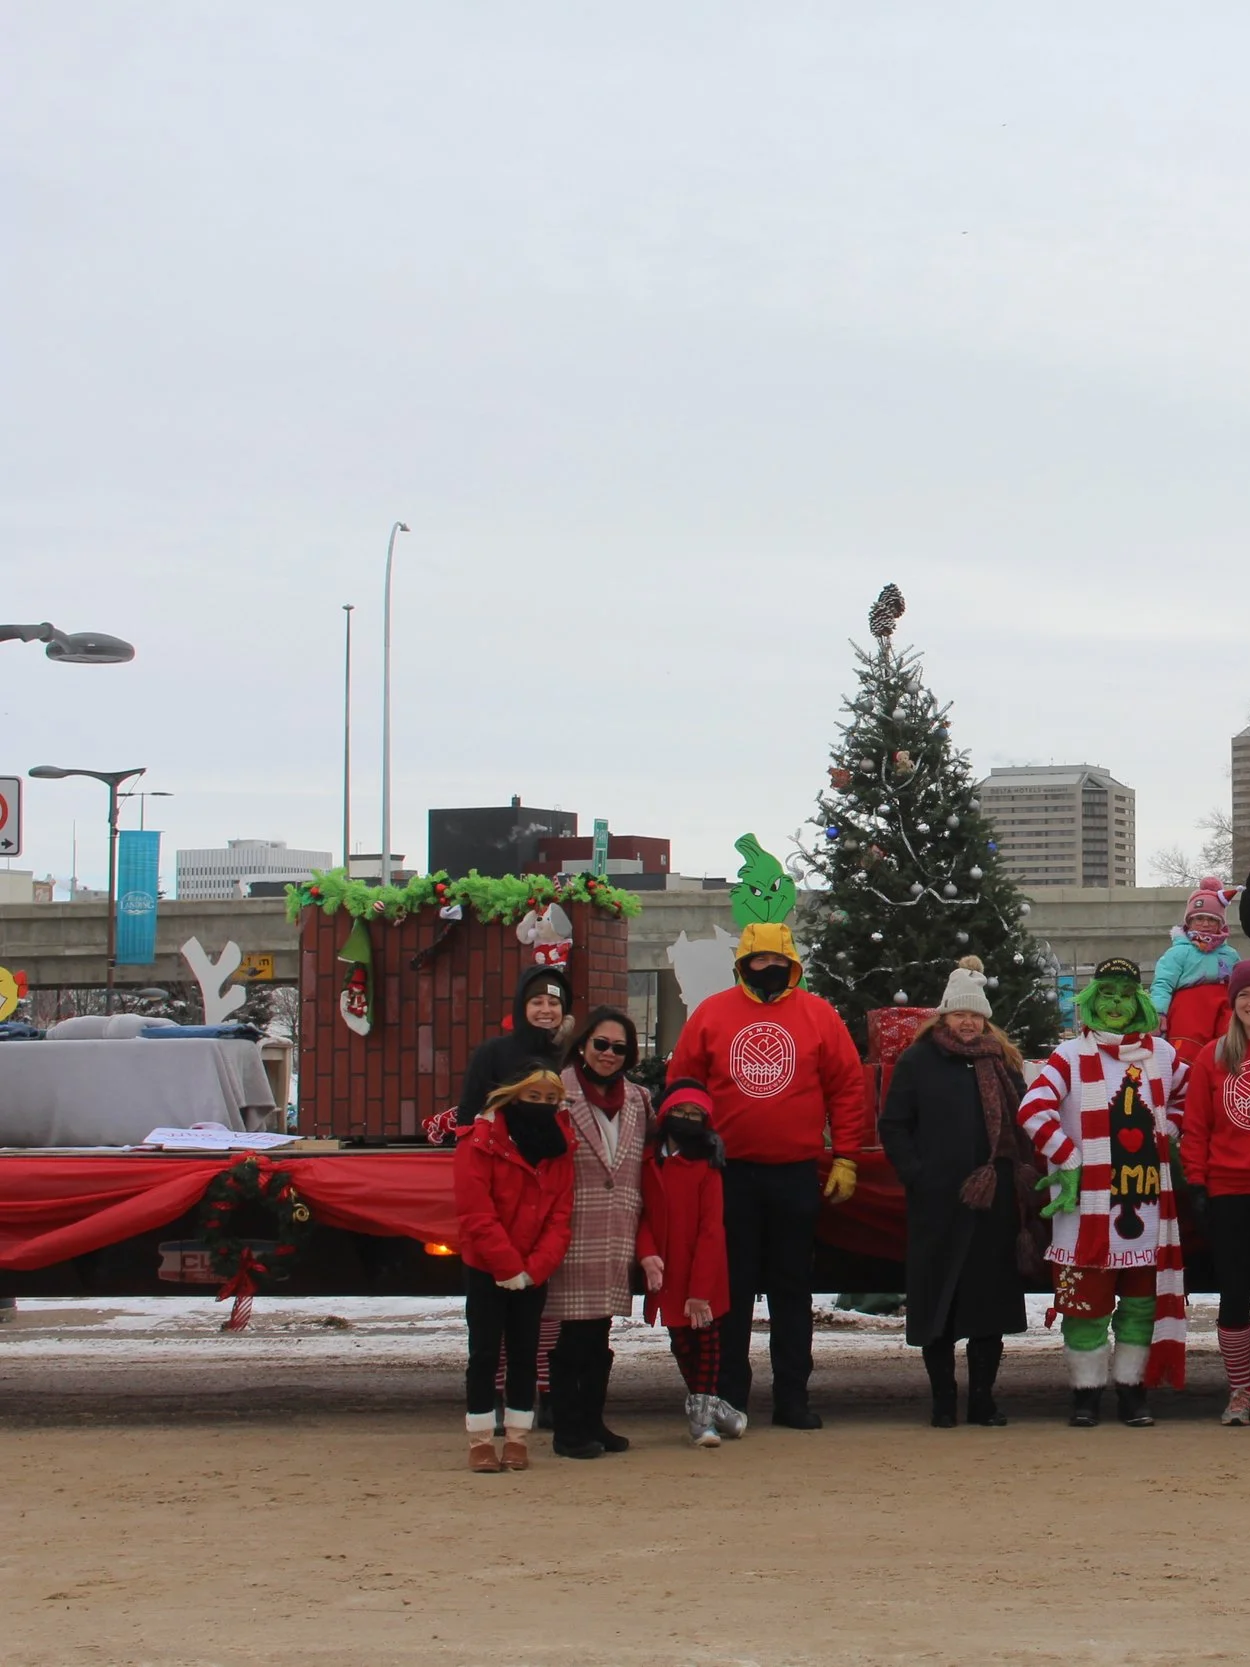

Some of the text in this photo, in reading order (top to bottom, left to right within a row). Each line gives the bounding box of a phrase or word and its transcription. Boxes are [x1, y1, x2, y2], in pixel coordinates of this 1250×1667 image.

[748, 1027, 781, 1037] RMHC
[737, 1072, 786, 1092] SASKATCHEWAN
[1124, 1086, 1134, 1115] I
